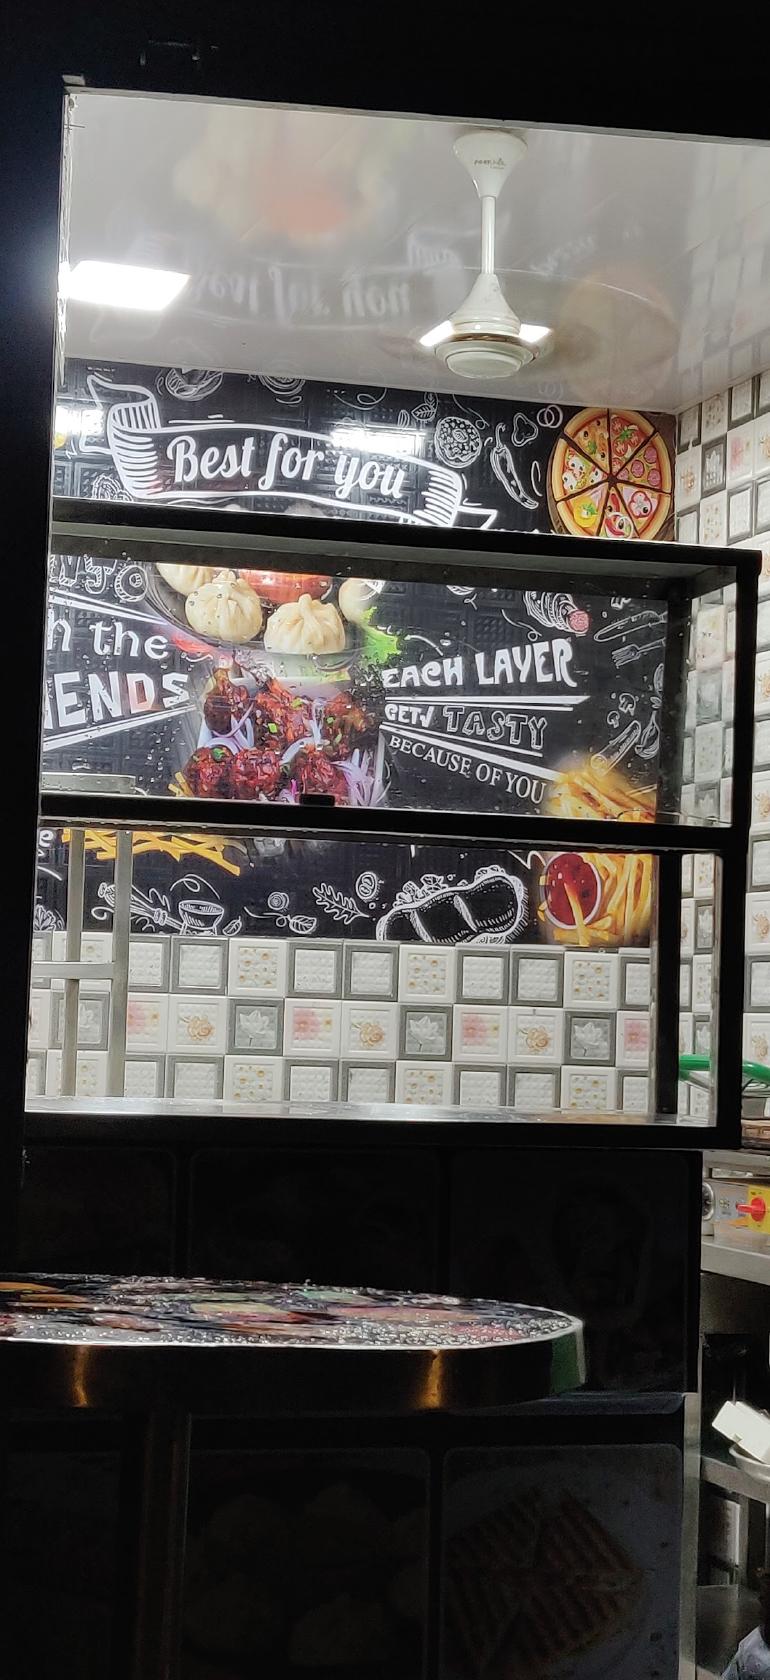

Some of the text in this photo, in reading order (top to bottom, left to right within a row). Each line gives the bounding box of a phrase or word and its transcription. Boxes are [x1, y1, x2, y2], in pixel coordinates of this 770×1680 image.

[166, 431, 406, 499] Best for you
[88, 619, 169, 660] the
[381, 638, 578, 688] EACH LAYER
[442, 704, 548, 750] TASTY
[389, 735, 547, 805] BECAUSE OF YOU
